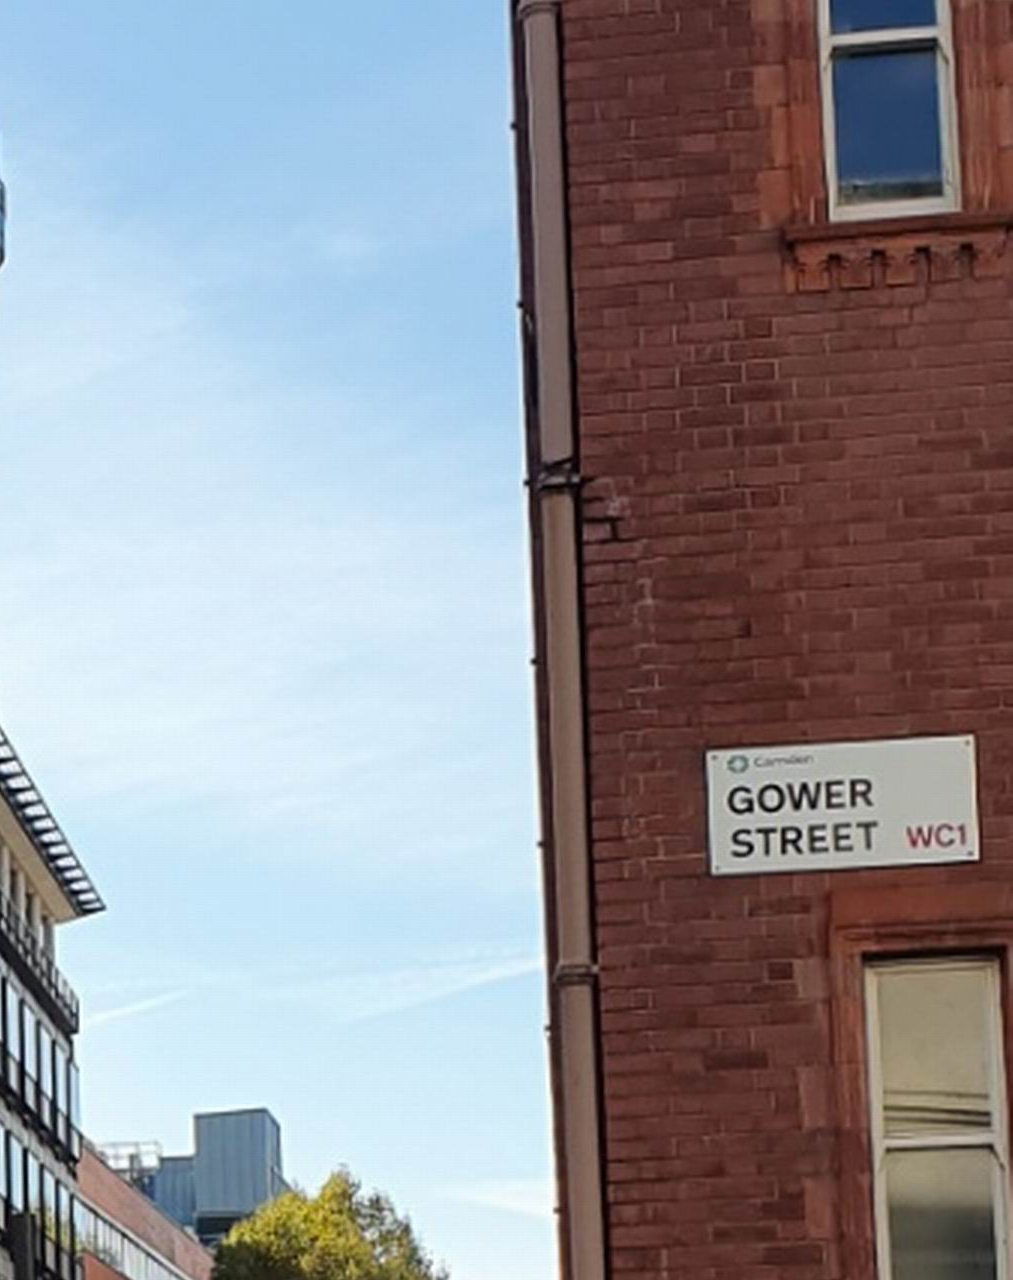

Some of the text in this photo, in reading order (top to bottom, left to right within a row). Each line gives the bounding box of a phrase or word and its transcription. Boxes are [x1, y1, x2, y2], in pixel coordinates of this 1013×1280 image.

[753, 753, 814, 769] Camden
[727, 778, 874, 815] GOWER
[731, 821, 968, 858] STREET WC1
